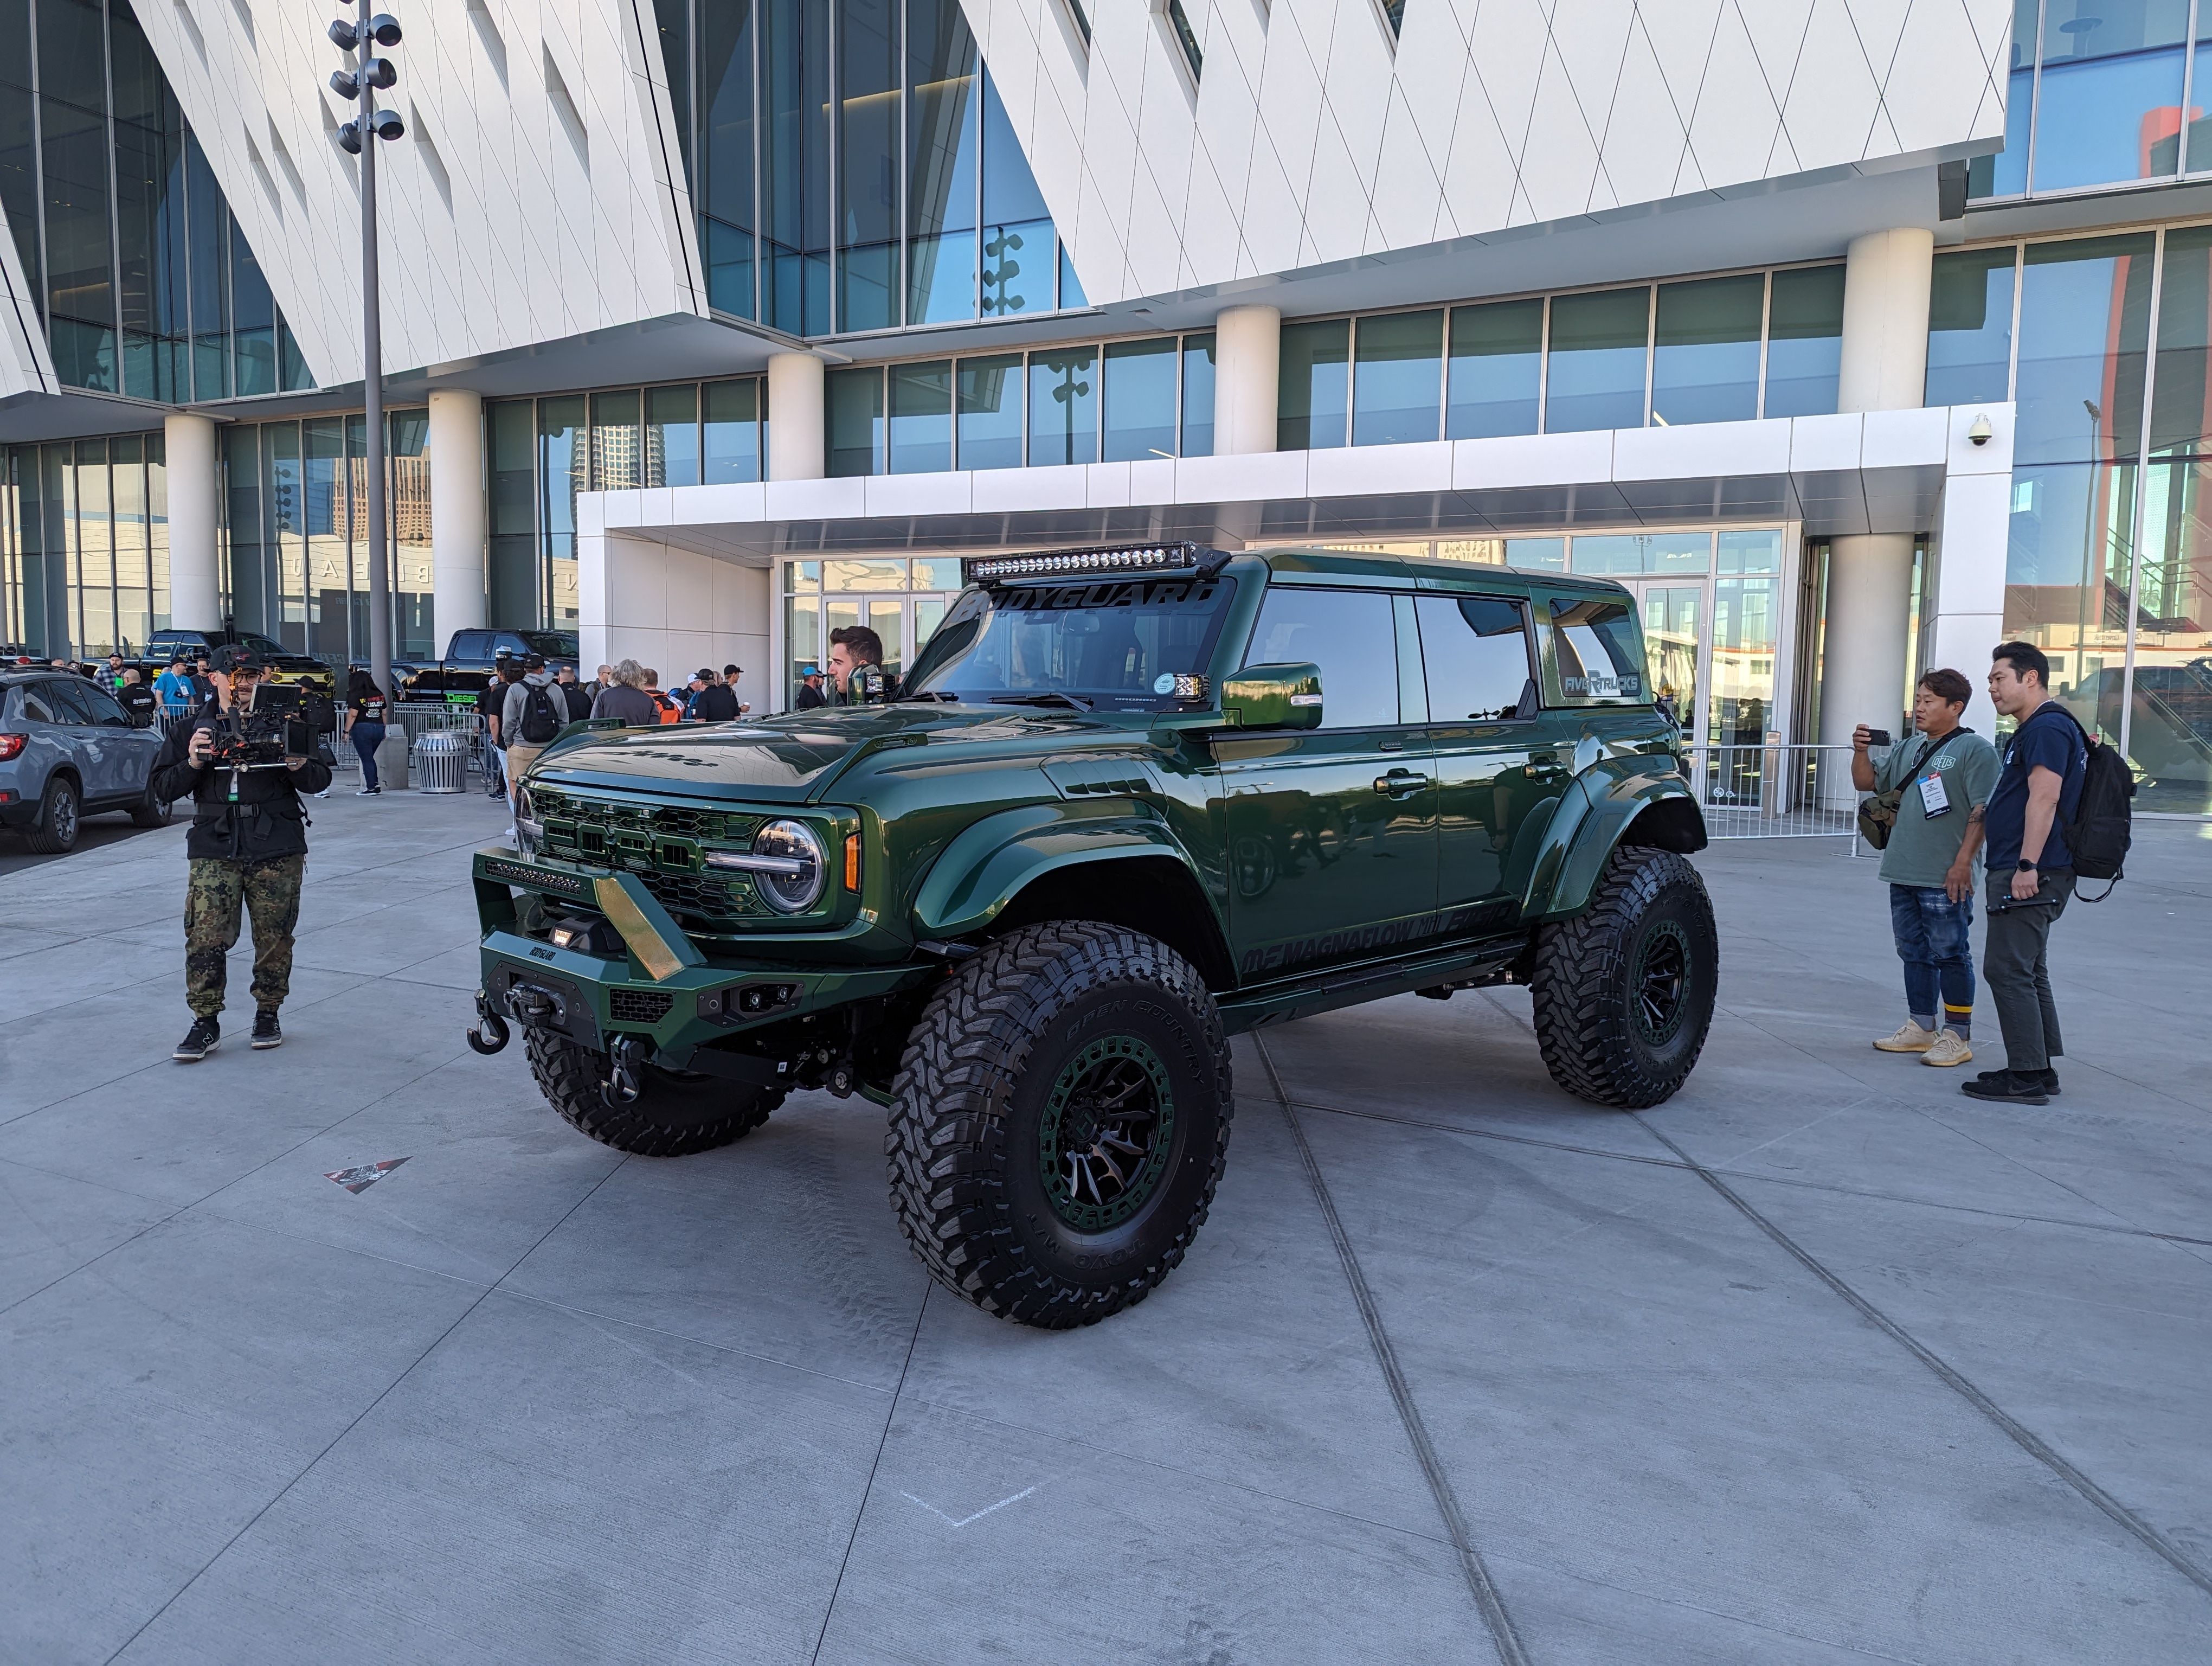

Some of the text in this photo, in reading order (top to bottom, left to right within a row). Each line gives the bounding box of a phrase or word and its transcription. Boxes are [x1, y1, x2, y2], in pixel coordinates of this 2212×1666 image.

[1282, 920, 1414, 965] MAGNAFLOW
[1066, 999, 1205, 1084] OPEN COUNTRY
